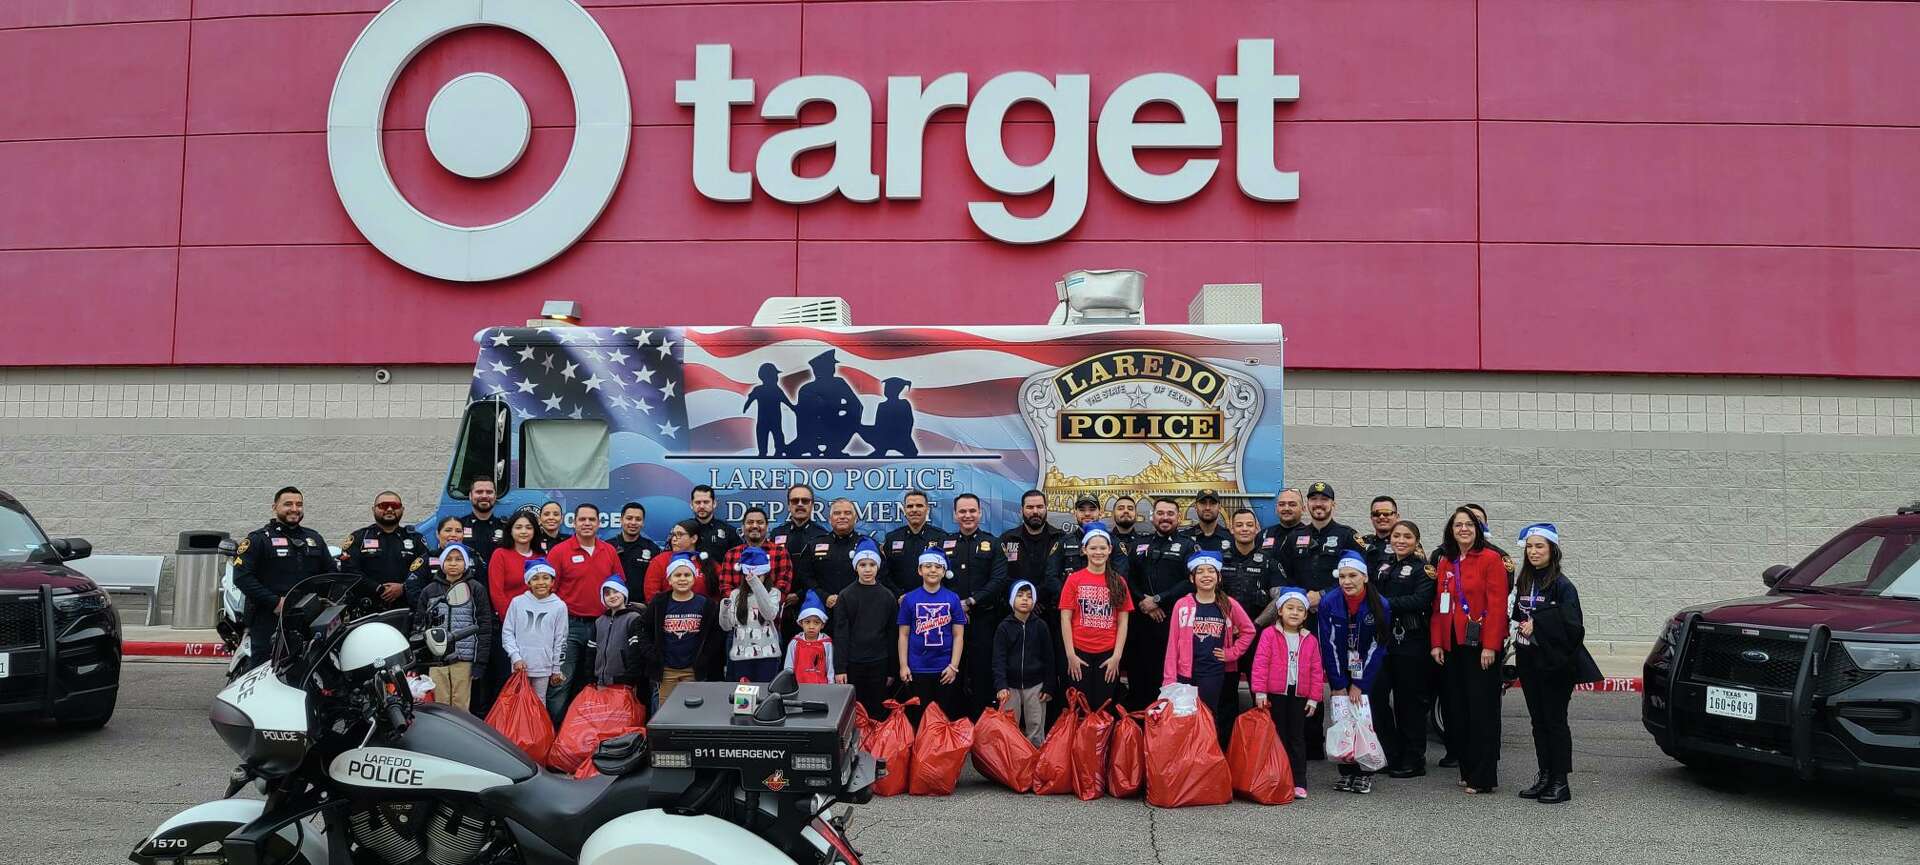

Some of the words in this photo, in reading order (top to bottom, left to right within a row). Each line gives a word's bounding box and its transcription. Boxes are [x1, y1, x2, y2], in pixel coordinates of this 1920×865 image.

[675, 38, 1300, 245] target
[1062, 353, 1217, 396] LAREDO
[1068, 415, 1214, 438] POLICE
[710, 468, 833, 490] LAREDO
[845, 468, 955, 490] POLICE
[184, 643, 203, 655] NO
[1603, 679, 1636, 692] FIRE
[1722, 690, 1741, 698] TEXAS
[263, 730, 298, 741] POLICE
[364, 753, 412, 767] LAREDO
[694, 748, 716, 758] 911
[718, 748, 786, 760] EMERGENCY
[348, 760, 425, 786] POLICE
[151, 838, 188, 848] 1570
